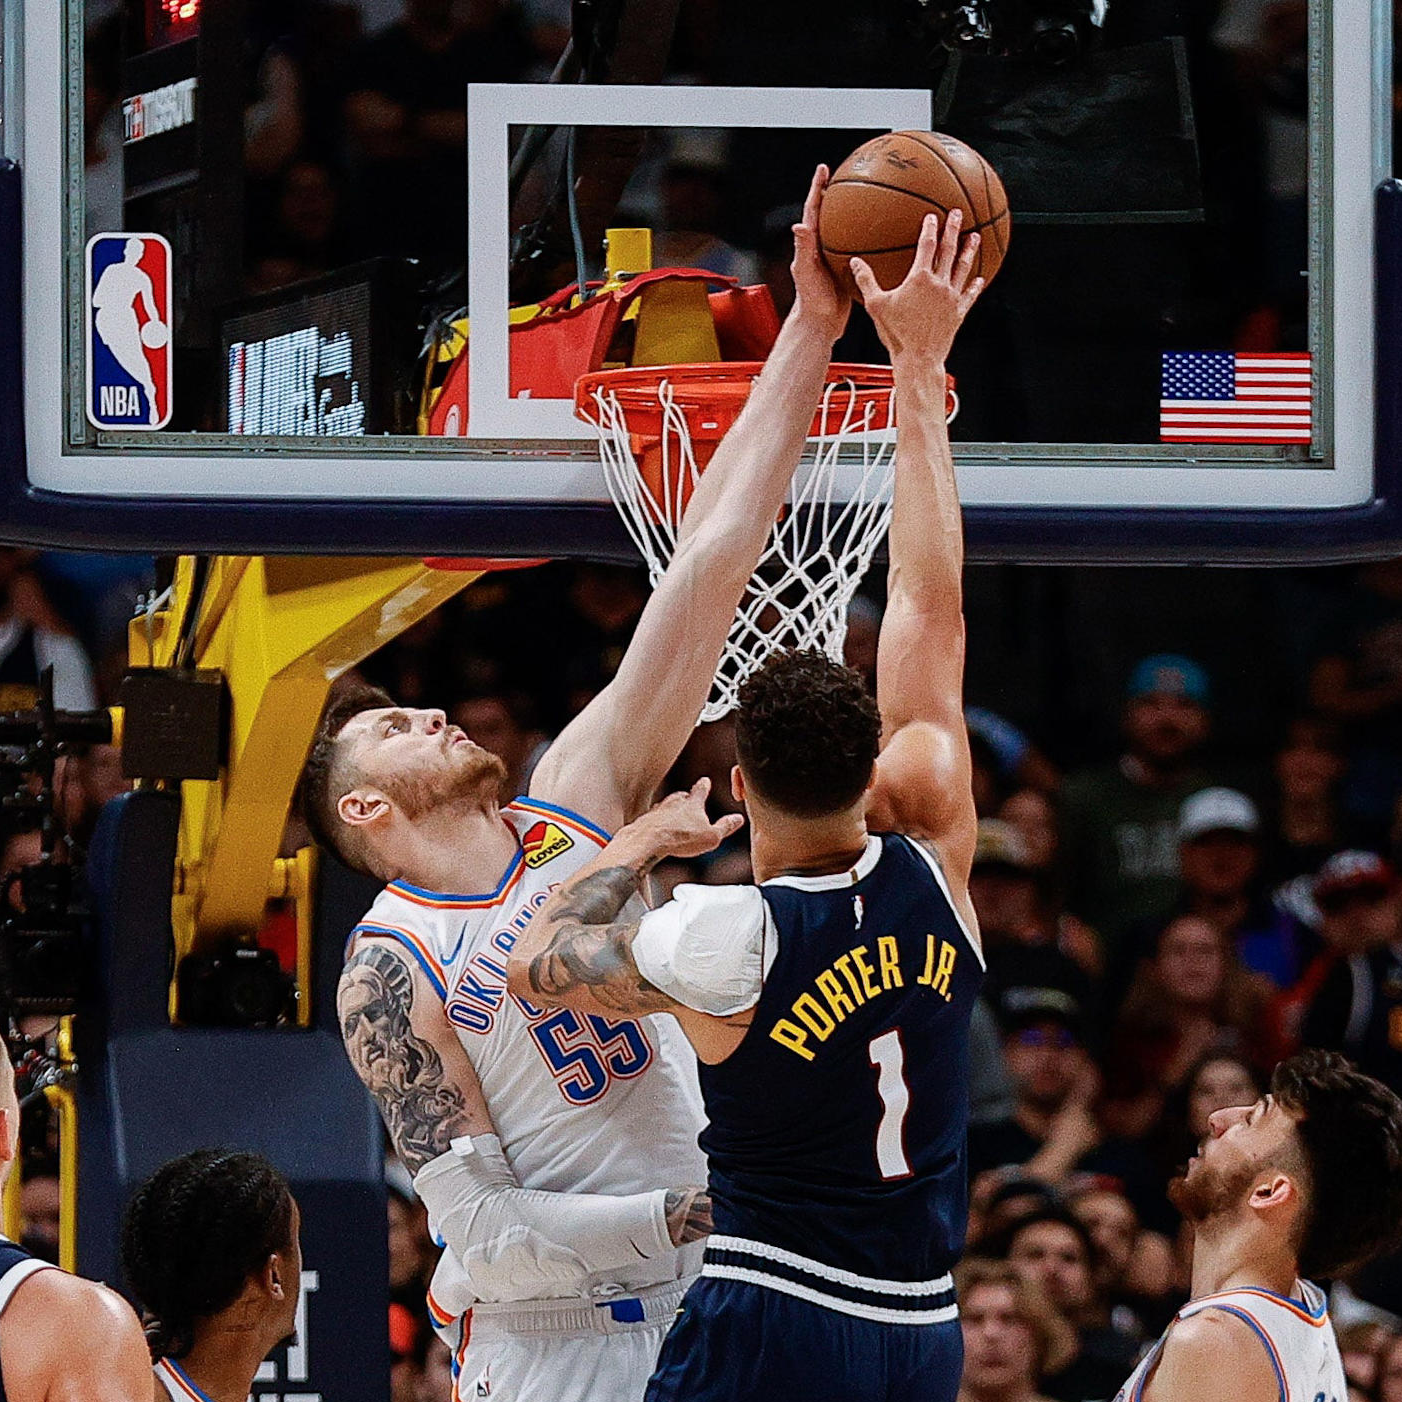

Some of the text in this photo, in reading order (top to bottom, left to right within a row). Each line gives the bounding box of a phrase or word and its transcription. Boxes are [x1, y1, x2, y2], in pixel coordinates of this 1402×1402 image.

[100, 385, 141, 416] NBA
[769, 934, 957, 1062] PORTER JR.
[528, 1005, 654, 1106] 55
[869, 1027, 912, 1181] 1
